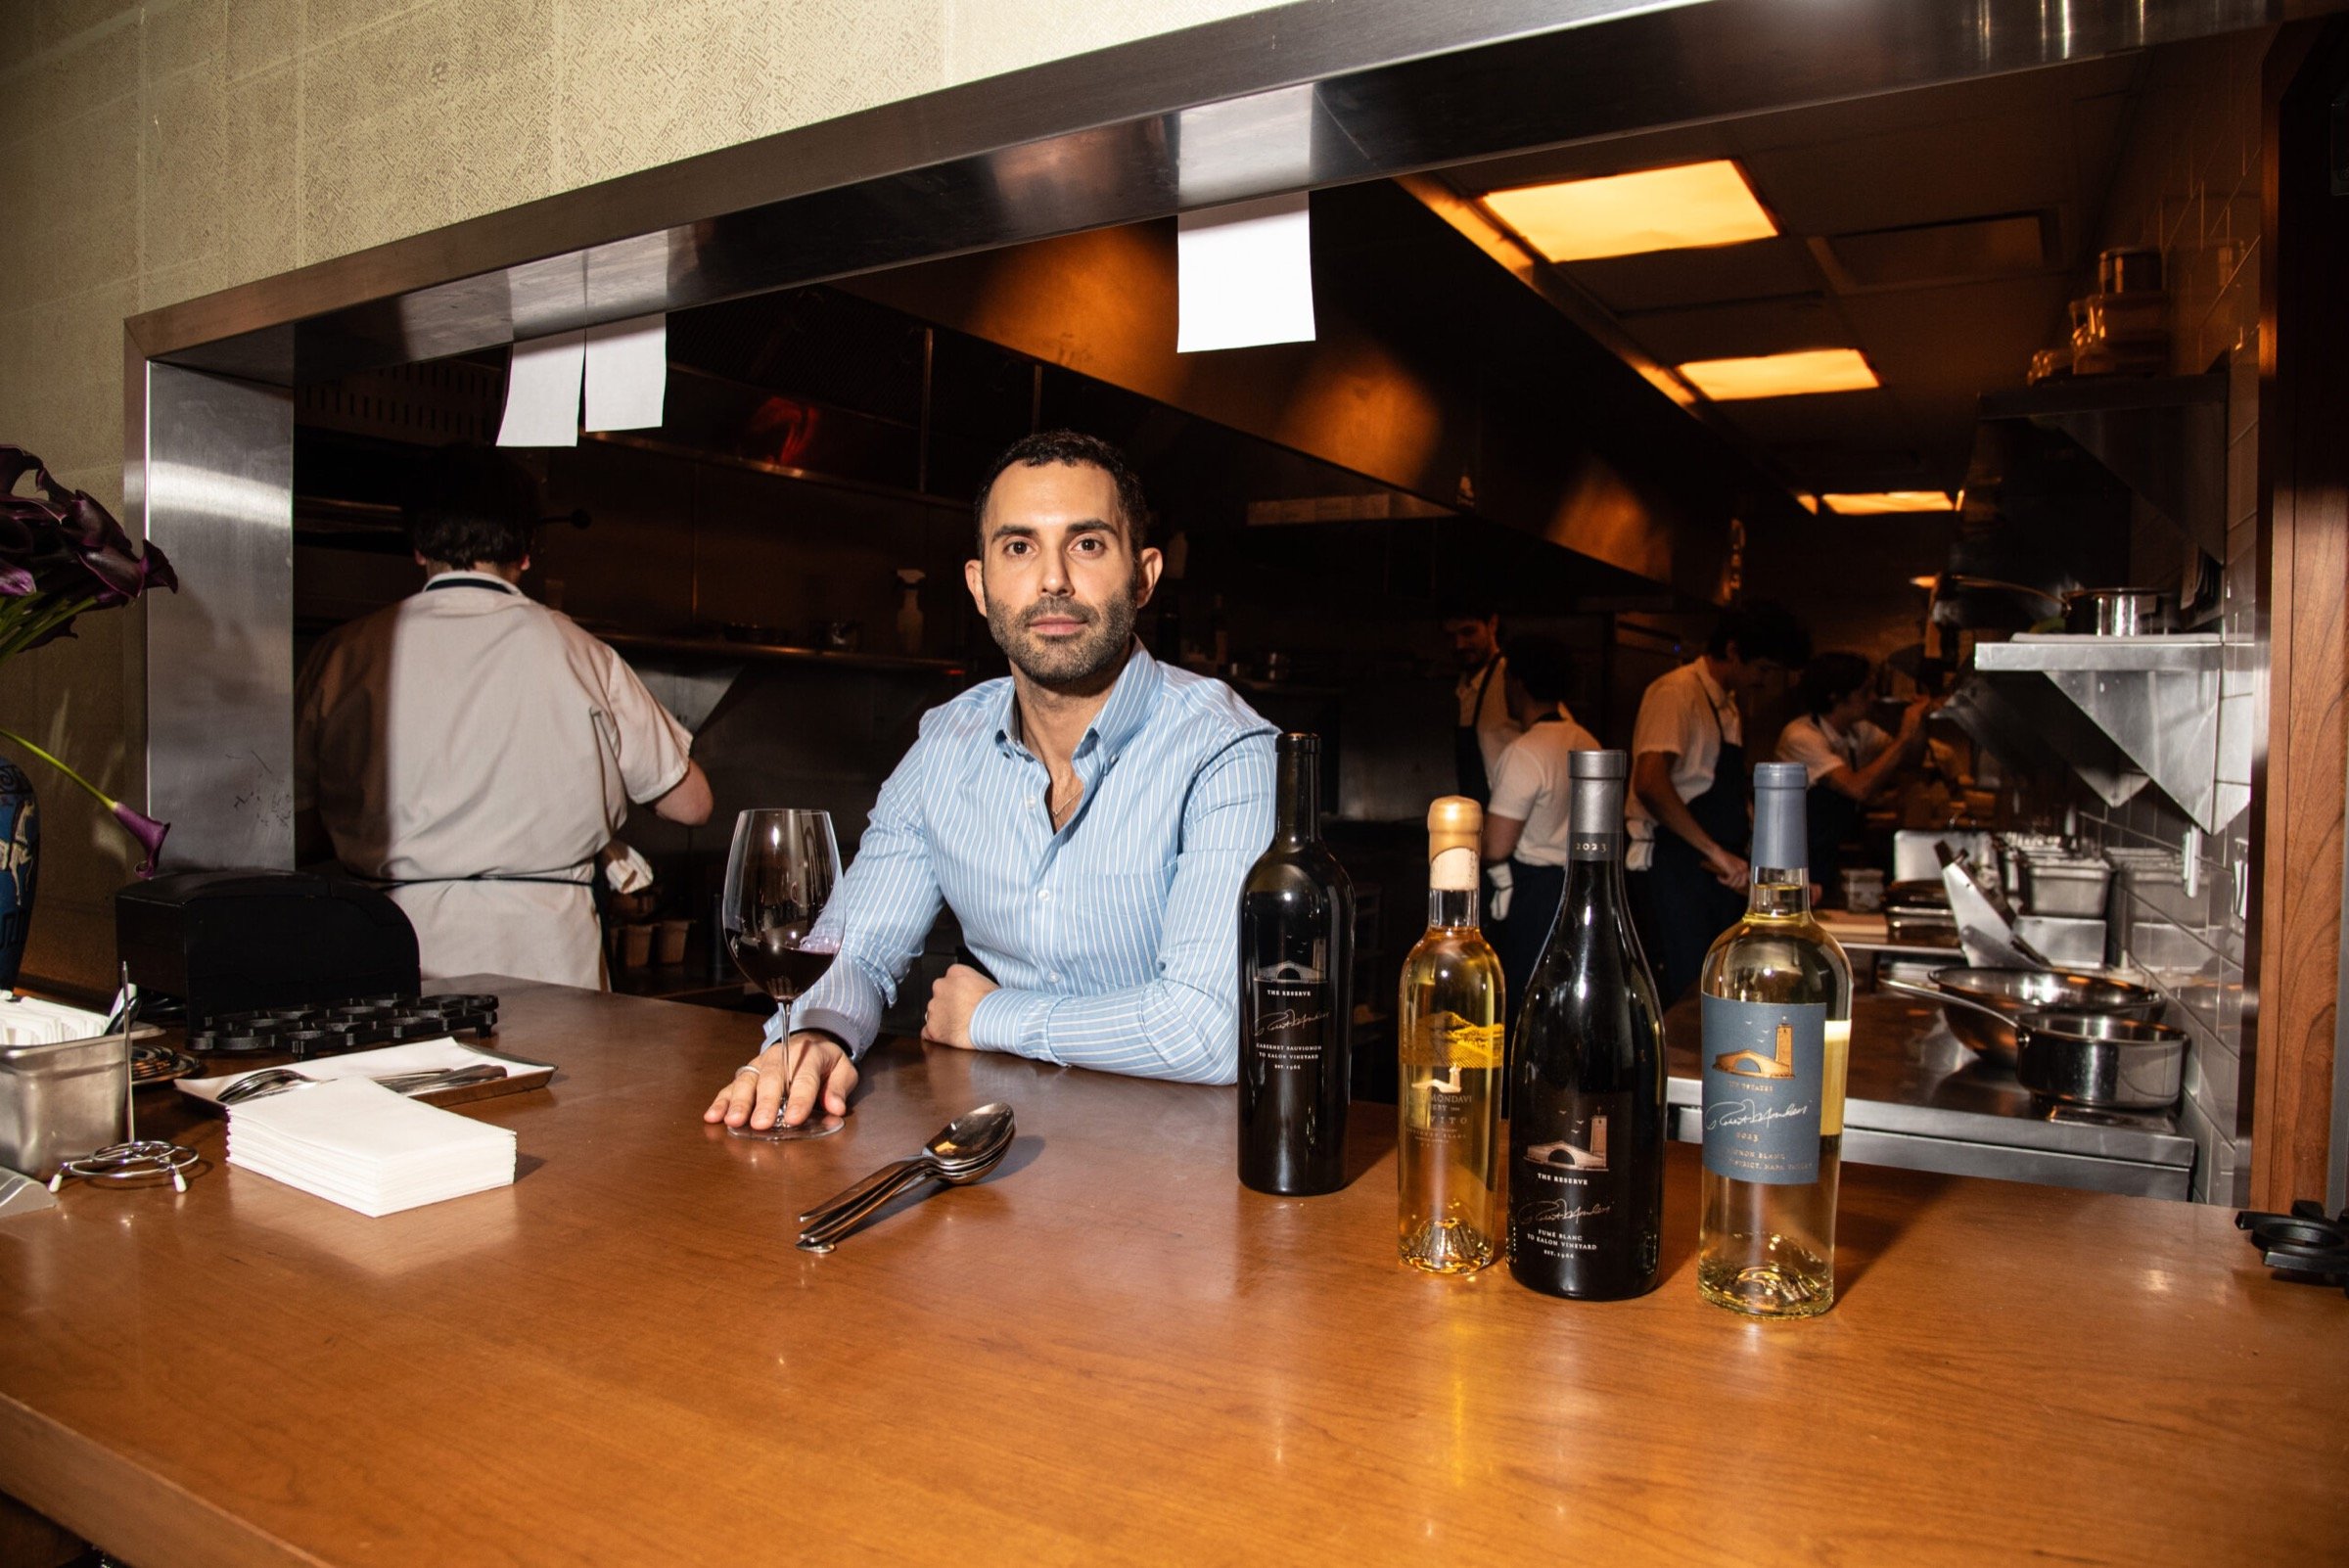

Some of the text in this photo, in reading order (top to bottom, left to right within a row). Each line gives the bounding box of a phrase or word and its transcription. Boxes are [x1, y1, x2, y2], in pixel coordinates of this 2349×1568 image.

[1576, 843, 1607, 853] 2023
[1538, 1173, 1589, 1185] THE RESERVE
[1537, 1236, 1558, 1247] KALON
[1561, 1240, 1597, 1250] VINEYARD
